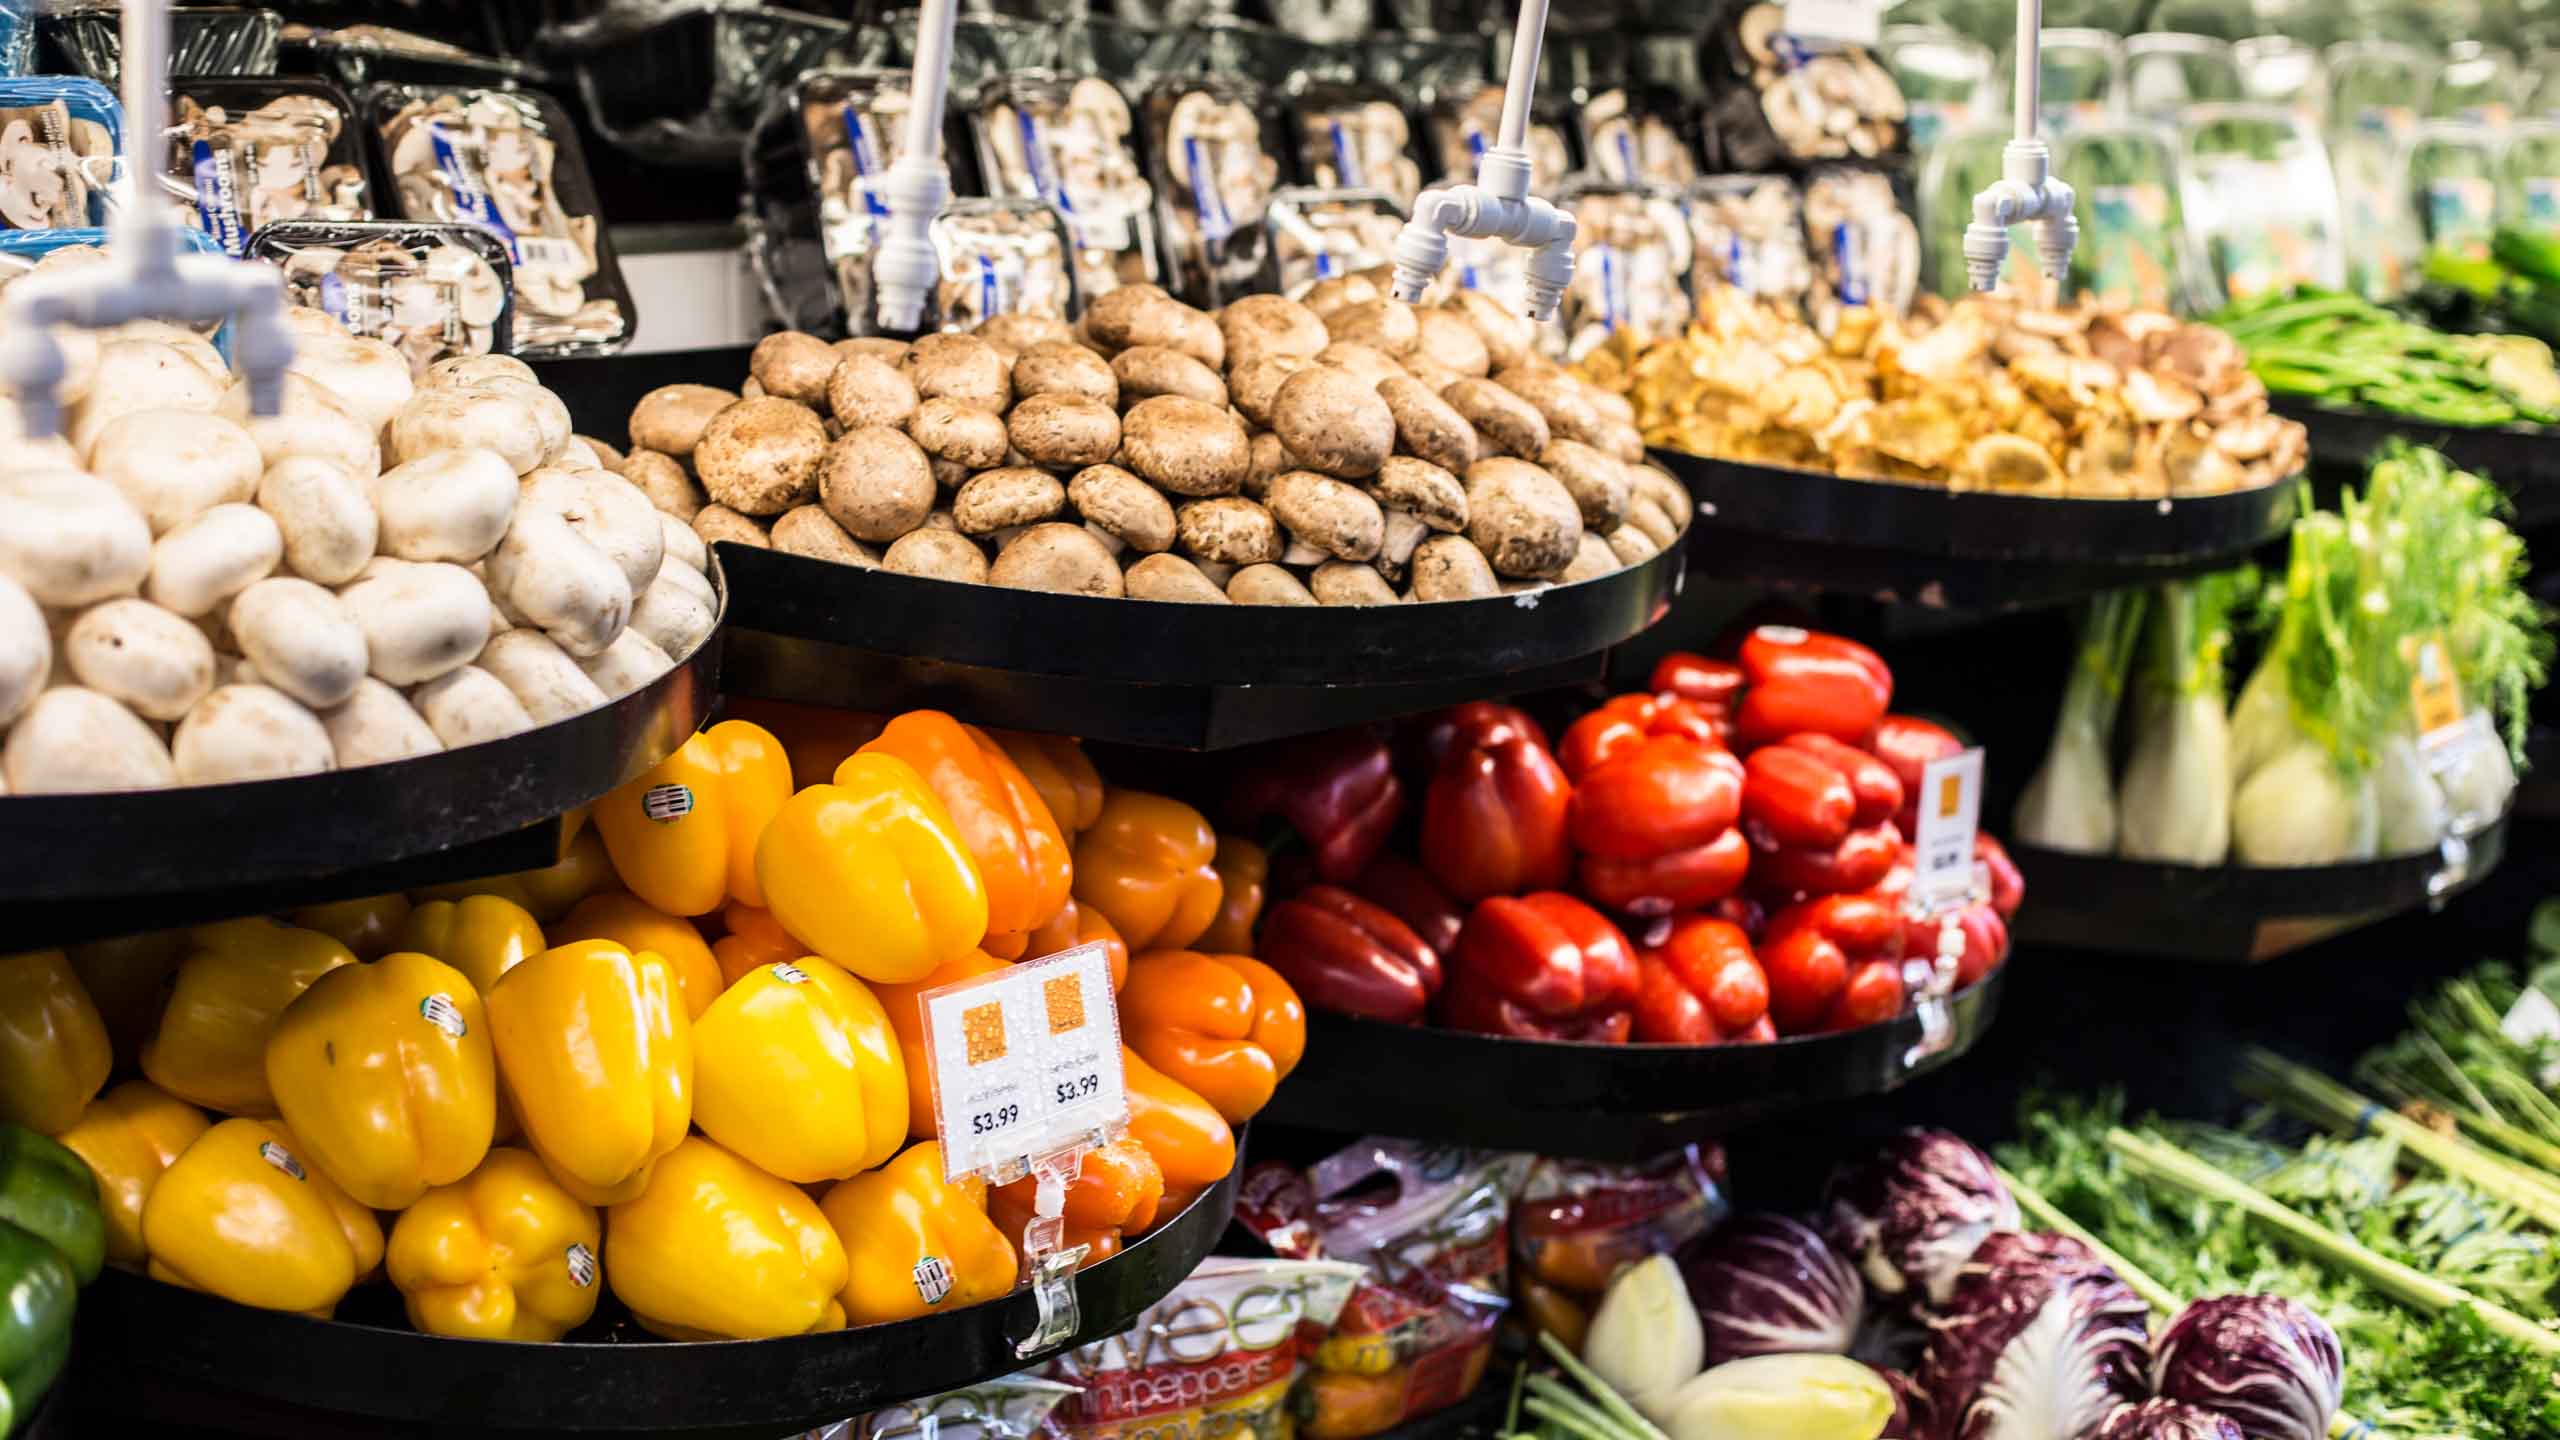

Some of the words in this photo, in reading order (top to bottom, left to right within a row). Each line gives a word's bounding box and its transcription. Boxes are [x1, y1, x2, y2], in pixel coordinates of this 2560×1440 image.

[214, 148, 243, 256] Mushrooms
[973, 1104, 1018, 1134] $3.99
[1056, 1074, 1098, 1103] $3.99
[1064, 1274, 1321, 1377] weet
